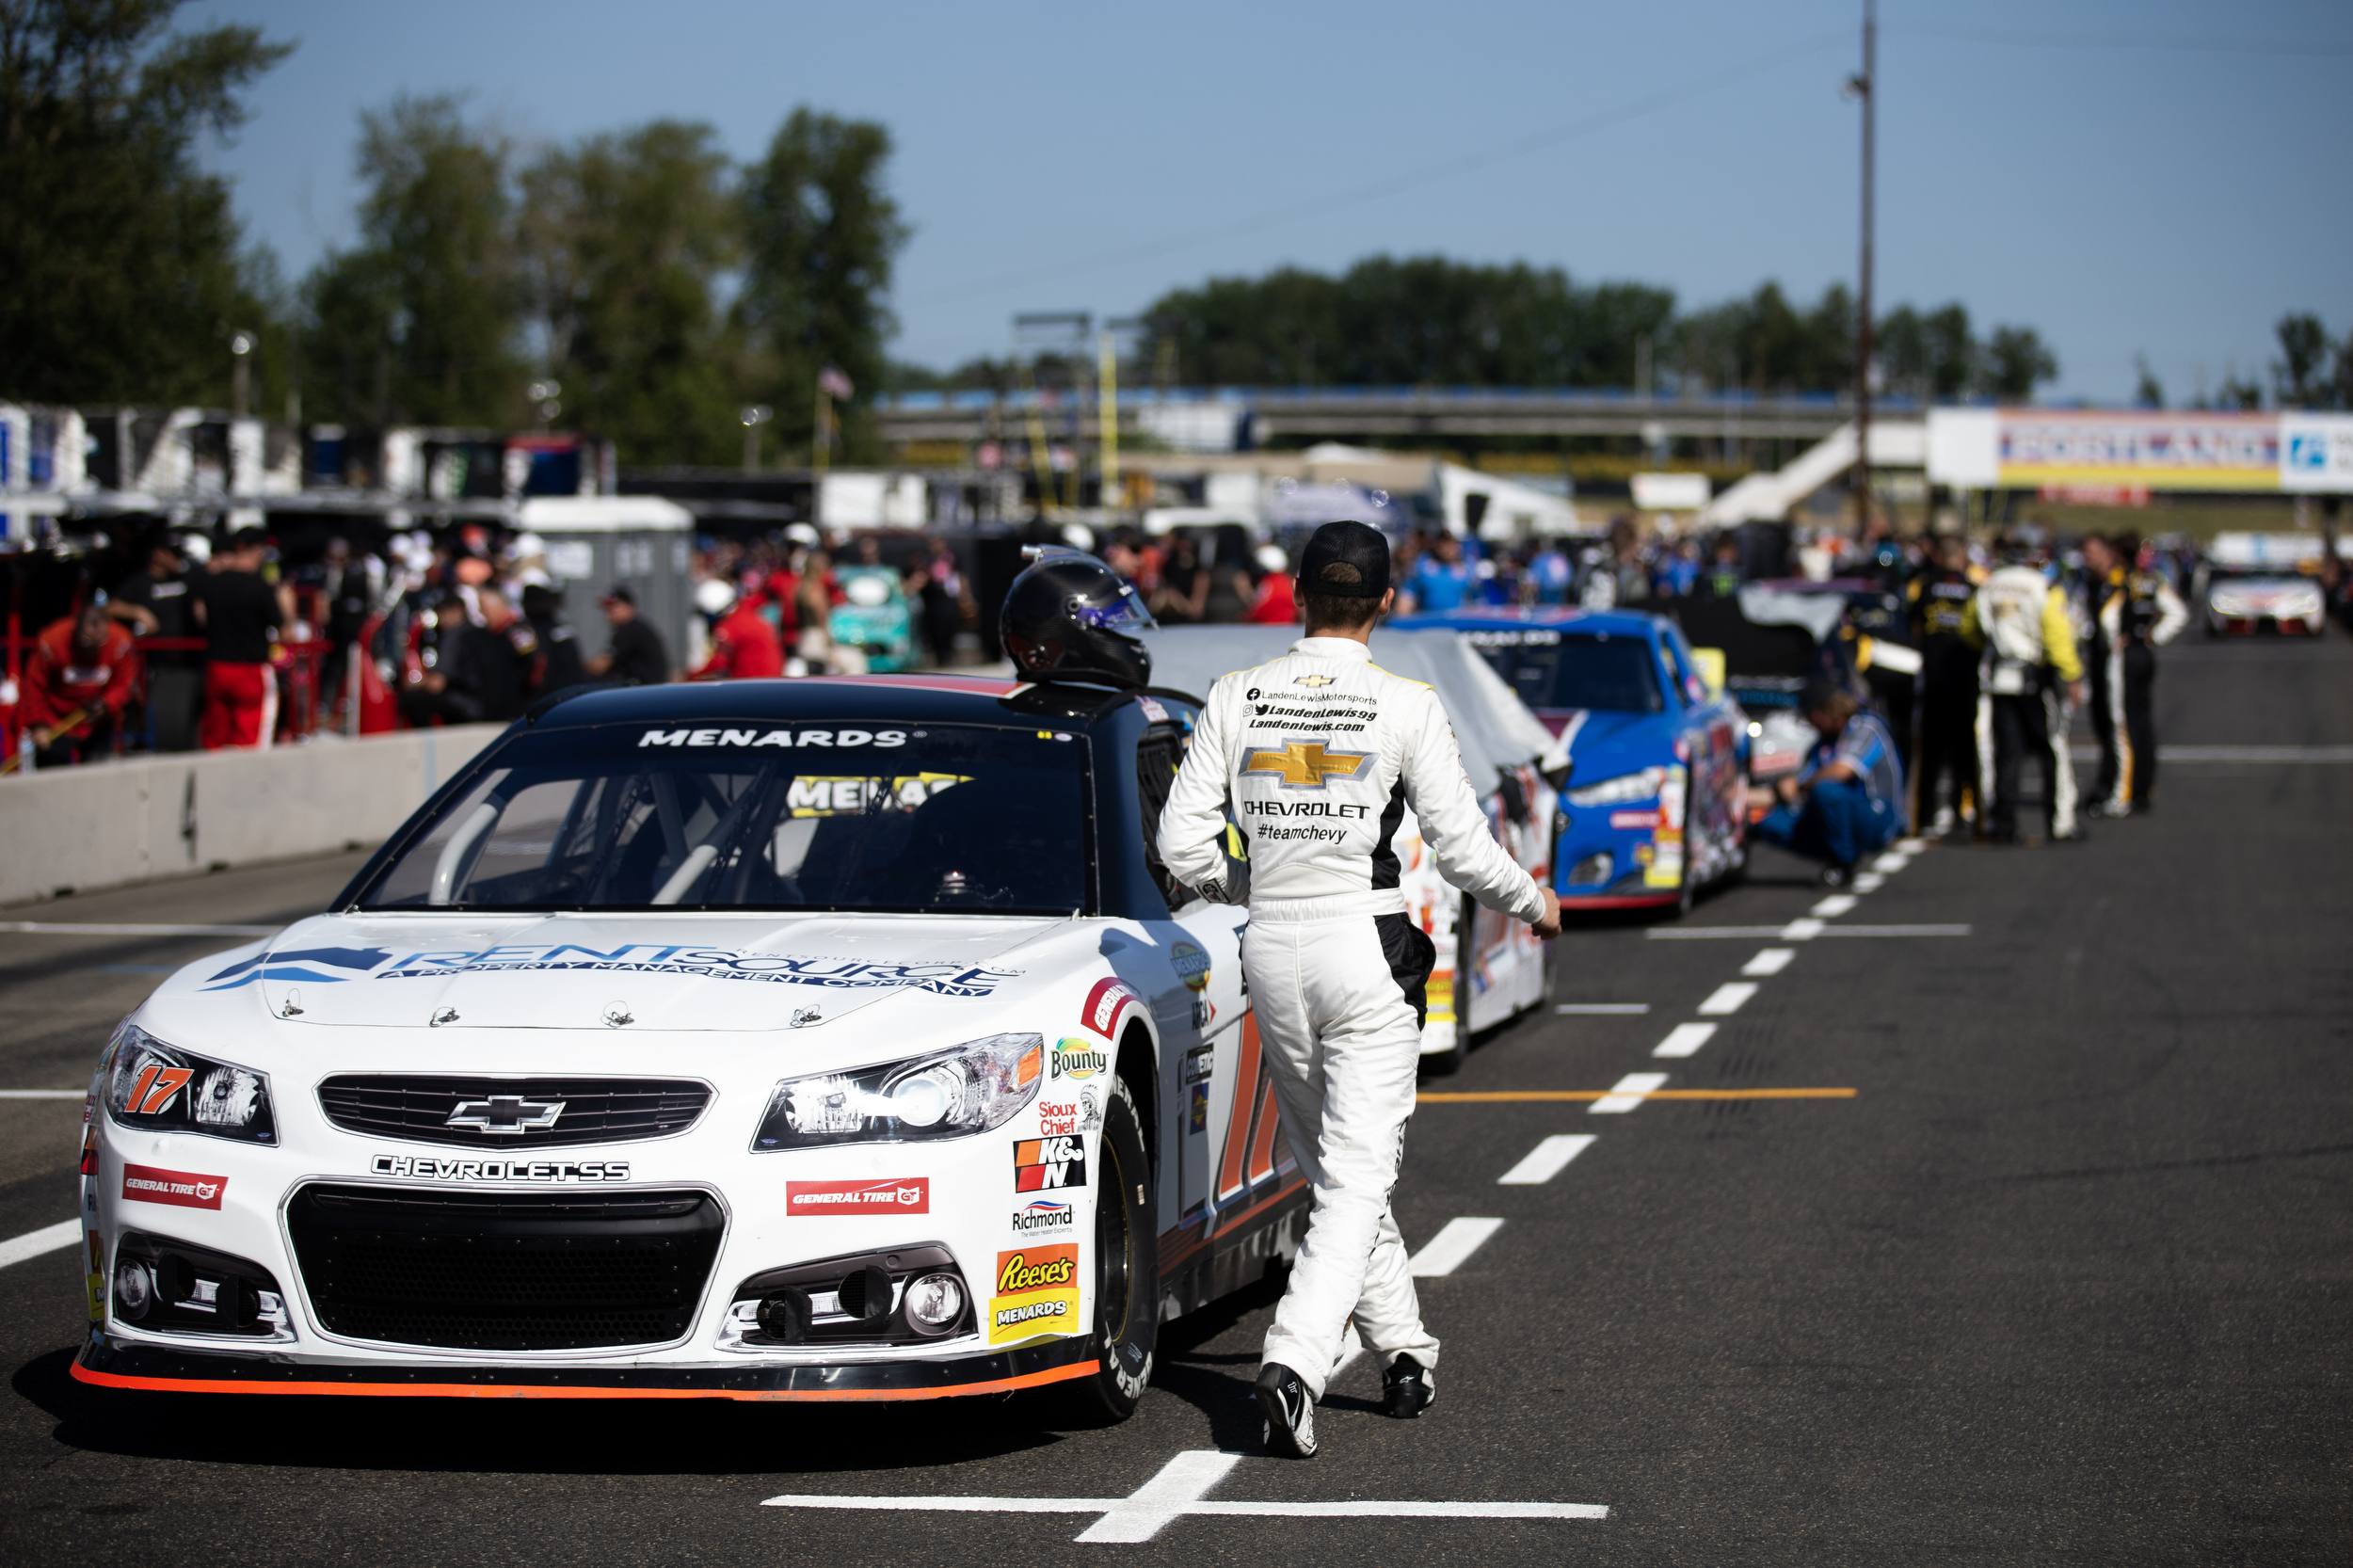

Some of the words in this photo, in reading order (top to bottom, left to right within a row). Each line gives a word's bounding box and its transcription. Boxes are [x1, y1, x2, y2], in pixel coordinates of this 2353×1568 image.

[1262, 691, 1378, 706] LandenLewisMotorsports
[637, 728, 907, 748] MENARDS
[1244, 800, 1370, 820] CHEVROLET
[1257, 824, 1348, 845] #teamchevy
[382, 970, 406, 979] A
[416, 962, 584, 977] PROPERTY
[590, 962, 816, 985] MANAGEMENT
[823, 977, 989, 997] COMPANY
[1050, 1049, 1107, 1080] Bounty
[124, 1064, 195, 1114] 17
[1039, 1101, 1078, 1118] Sioux
[1040, 1118, 1075, 1136] Chief
[1037, 1136, 1083, 1164] K&
[126, 1177, 169, 1192] GENERAL
[170, 1183, 196, 1195] TIRE
[1041, 1162, 1069, 1189] N
[792, 1192, 862, 1205] GENERAL
[862, 1192, 896, 1203] TIRE
[1013, 1204, 1072, 1231] Richmond
[998, 1253, 1076, 1293] Reese's
[996, 1301, 1067, 1327] MENARDS
